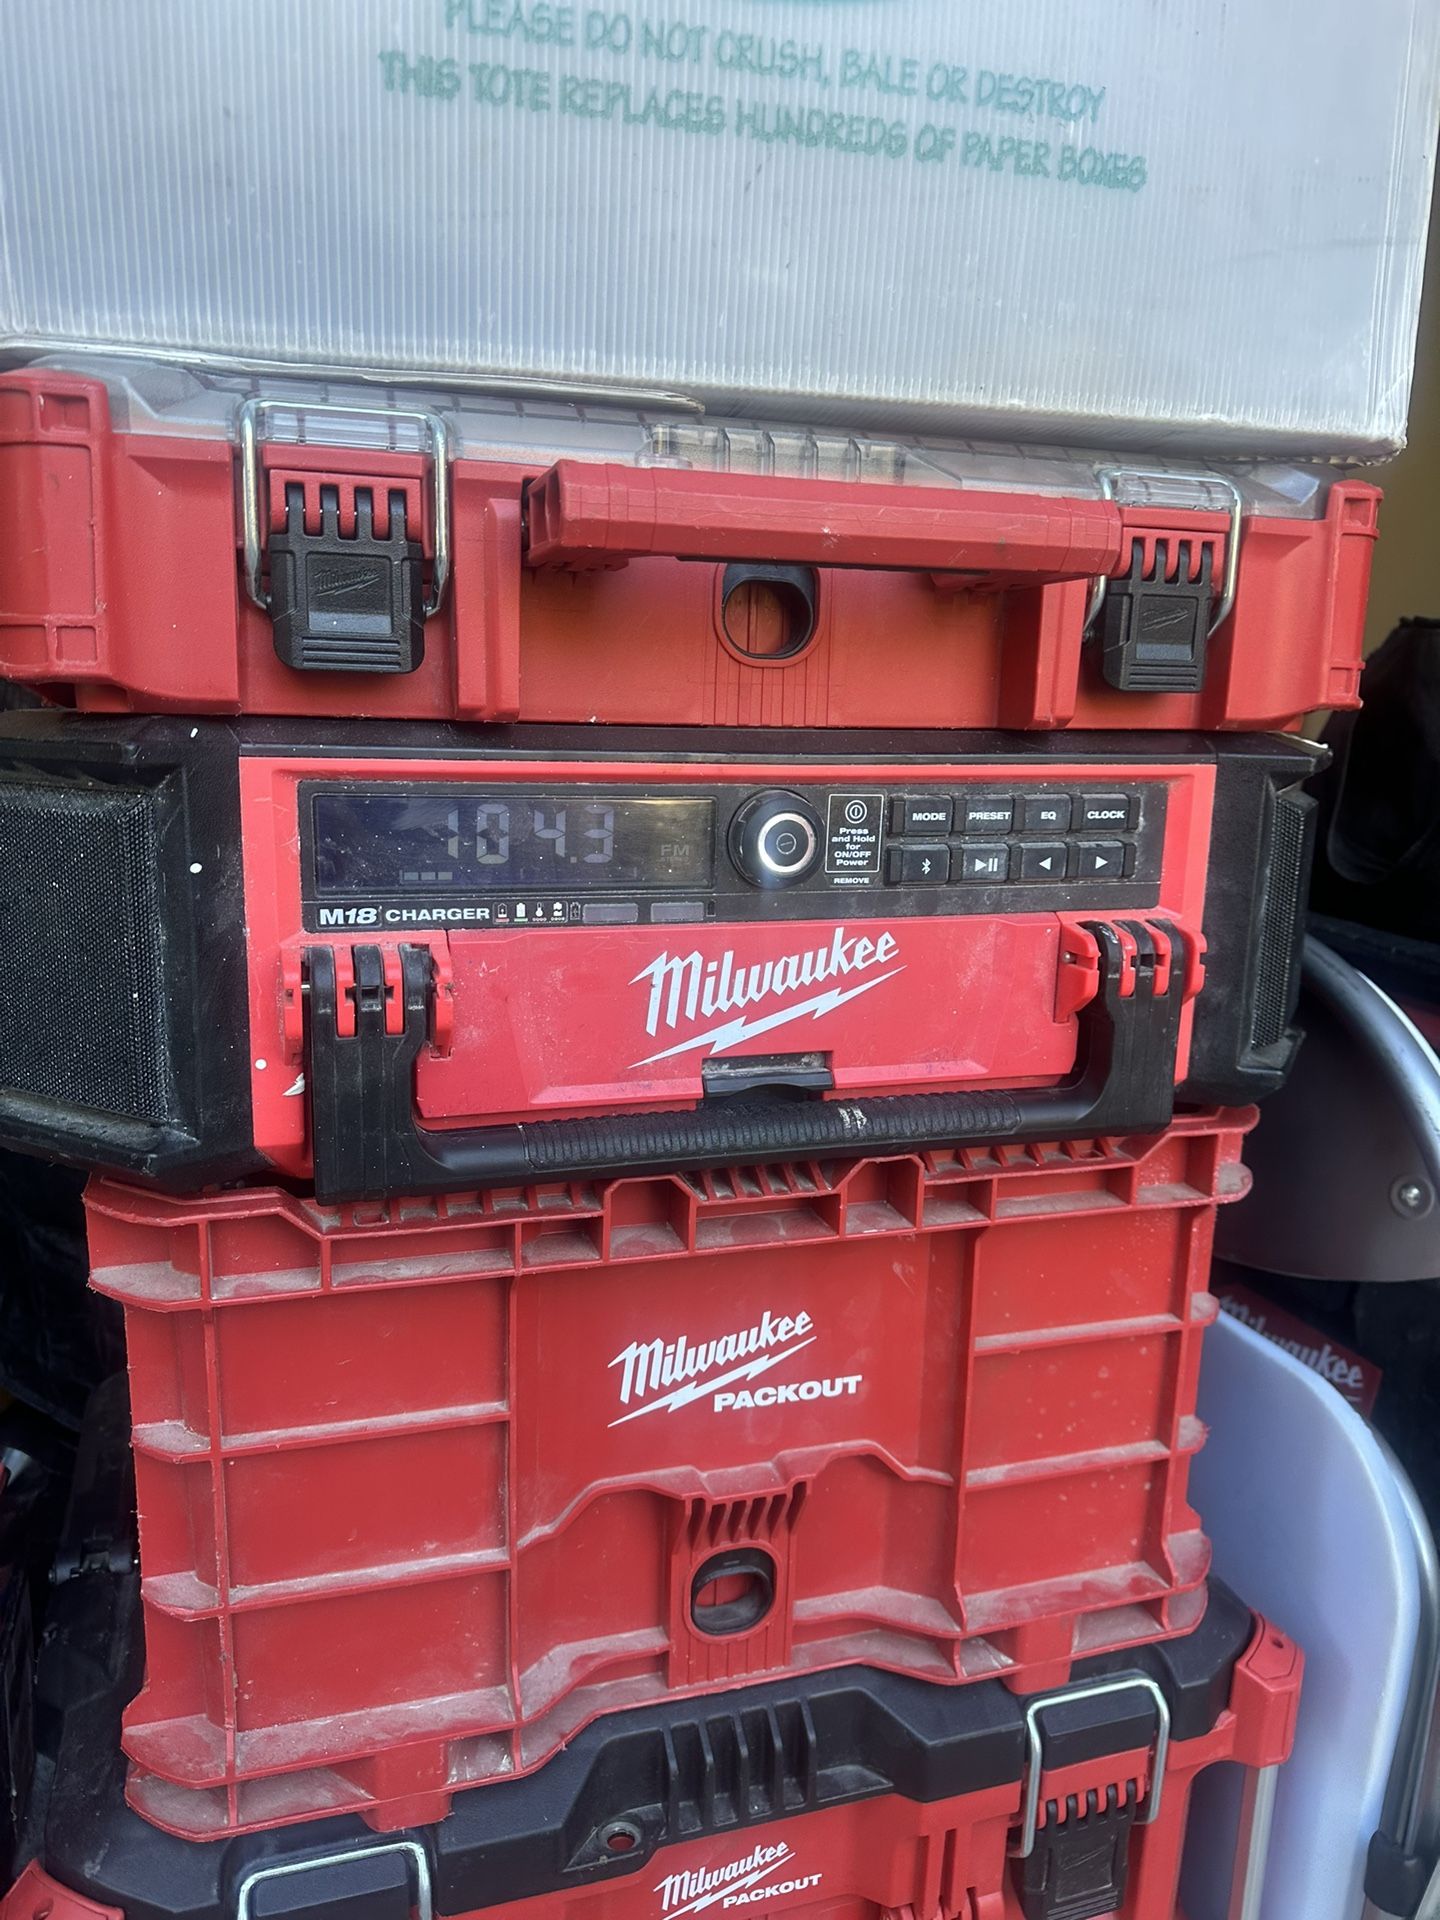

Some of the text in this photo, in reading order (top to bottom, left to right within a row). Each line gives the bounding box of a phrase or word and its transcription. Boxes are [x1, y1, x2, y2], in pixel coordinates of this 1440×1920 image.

[444, 0, 1106, 123] PLEASE DO NOT CRUSH, BALE OR DESTROY
[379, 49, 1147, 192] THIS TOTE REPLACES HUNDREDS OF PAPER BOXES
[911, 812, 947, 822] MODE
[968, 811, 1012, 821] PRESET
[1040, 811, 1057, 822] EQ
[1086, 810, 1126, 820] CLOCK
[831, 835, 876, 843] and Hold
[839, 827, 869, 835] Press
[661, 844, 690, 857] FM
[319, 907, 490, 925] M18 CHARGER
[628, 926, 899, 1037] Milwaukee
[608, 1310, 813, 1405] Milwaukee
[713, 1375, 863, 1412] PACKOUT
[653, 1841, 789, 1911] Milwaukee
[723, 1873, 822, 1909] PACKOUT
